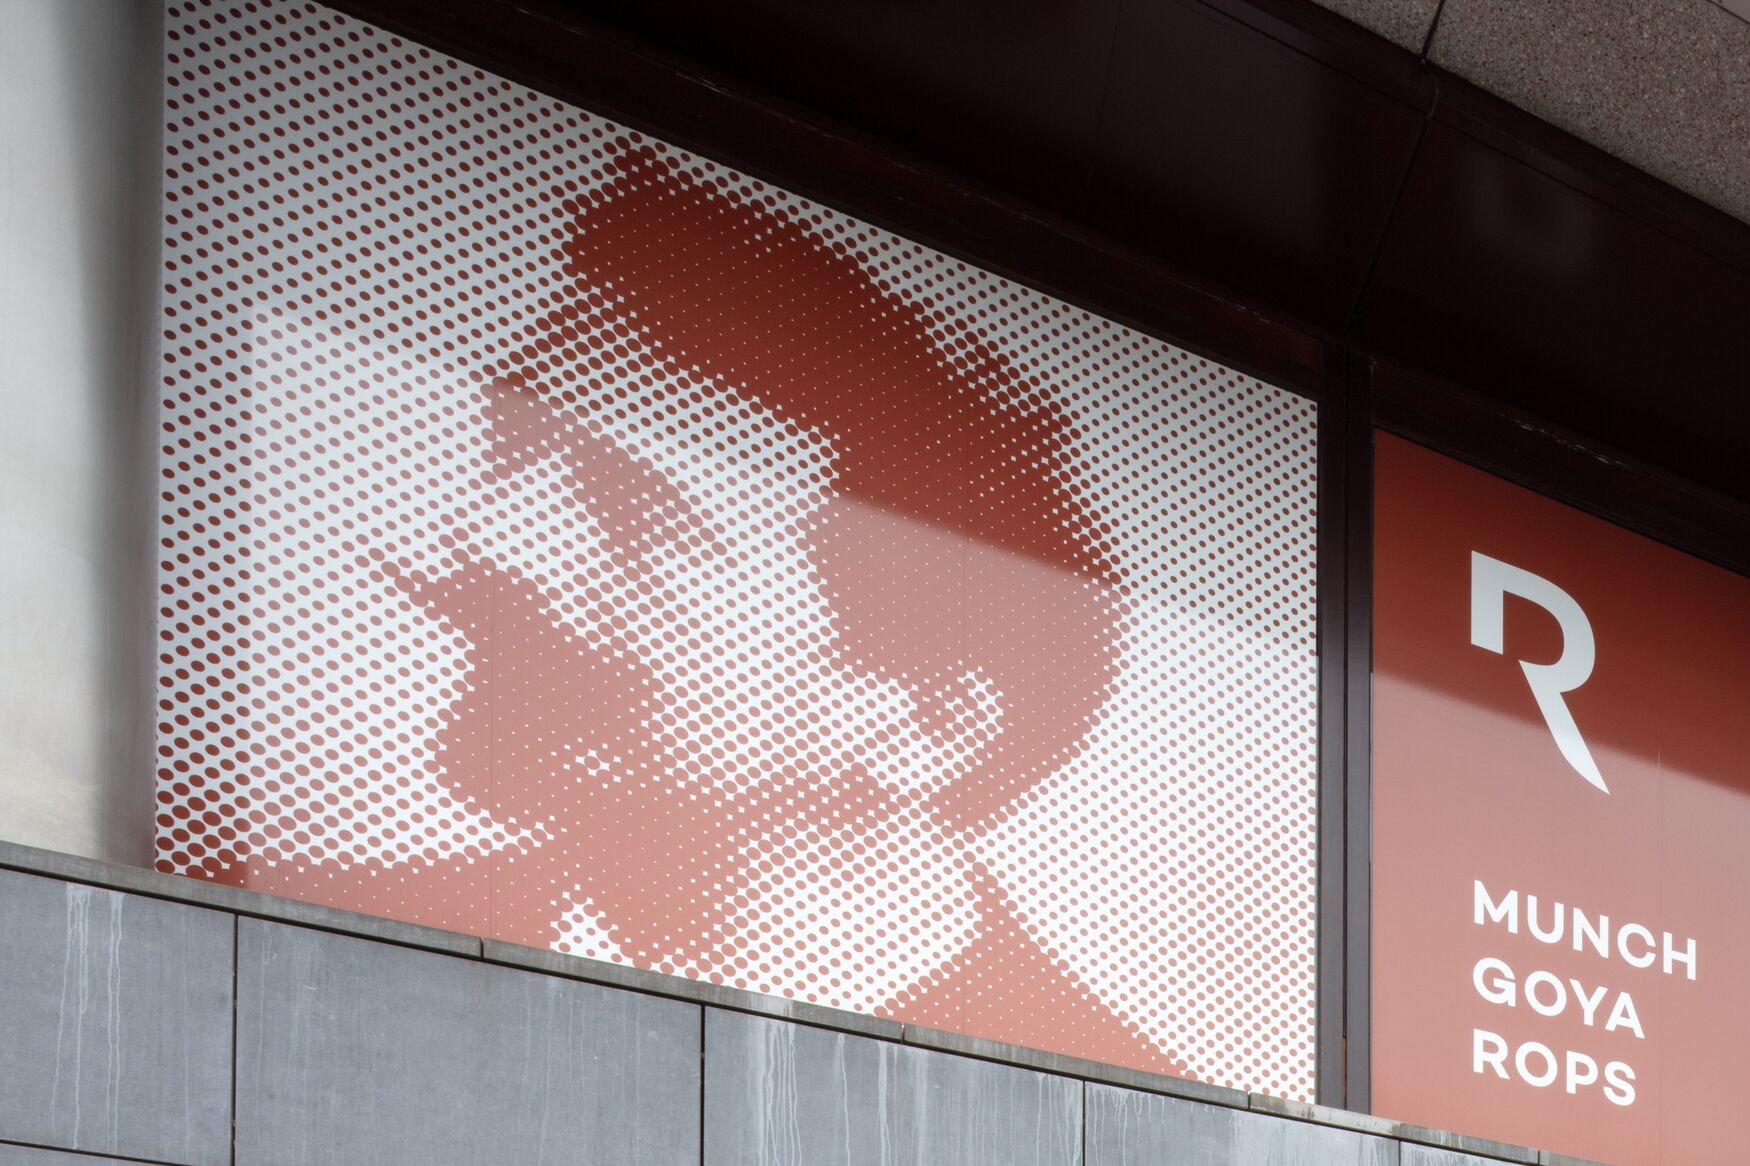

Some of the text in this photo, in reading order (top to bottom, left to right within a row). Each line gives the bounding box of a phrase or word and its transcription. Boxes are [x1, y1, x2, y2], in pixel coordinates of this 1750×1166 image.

[1470, 550, 1611, 795] R
[1473, 879, 1697, 981] MUNCH
[1472, 957, 1645, 1039] GOYA
[1472, 1028, 1636, 1106] ROPS
